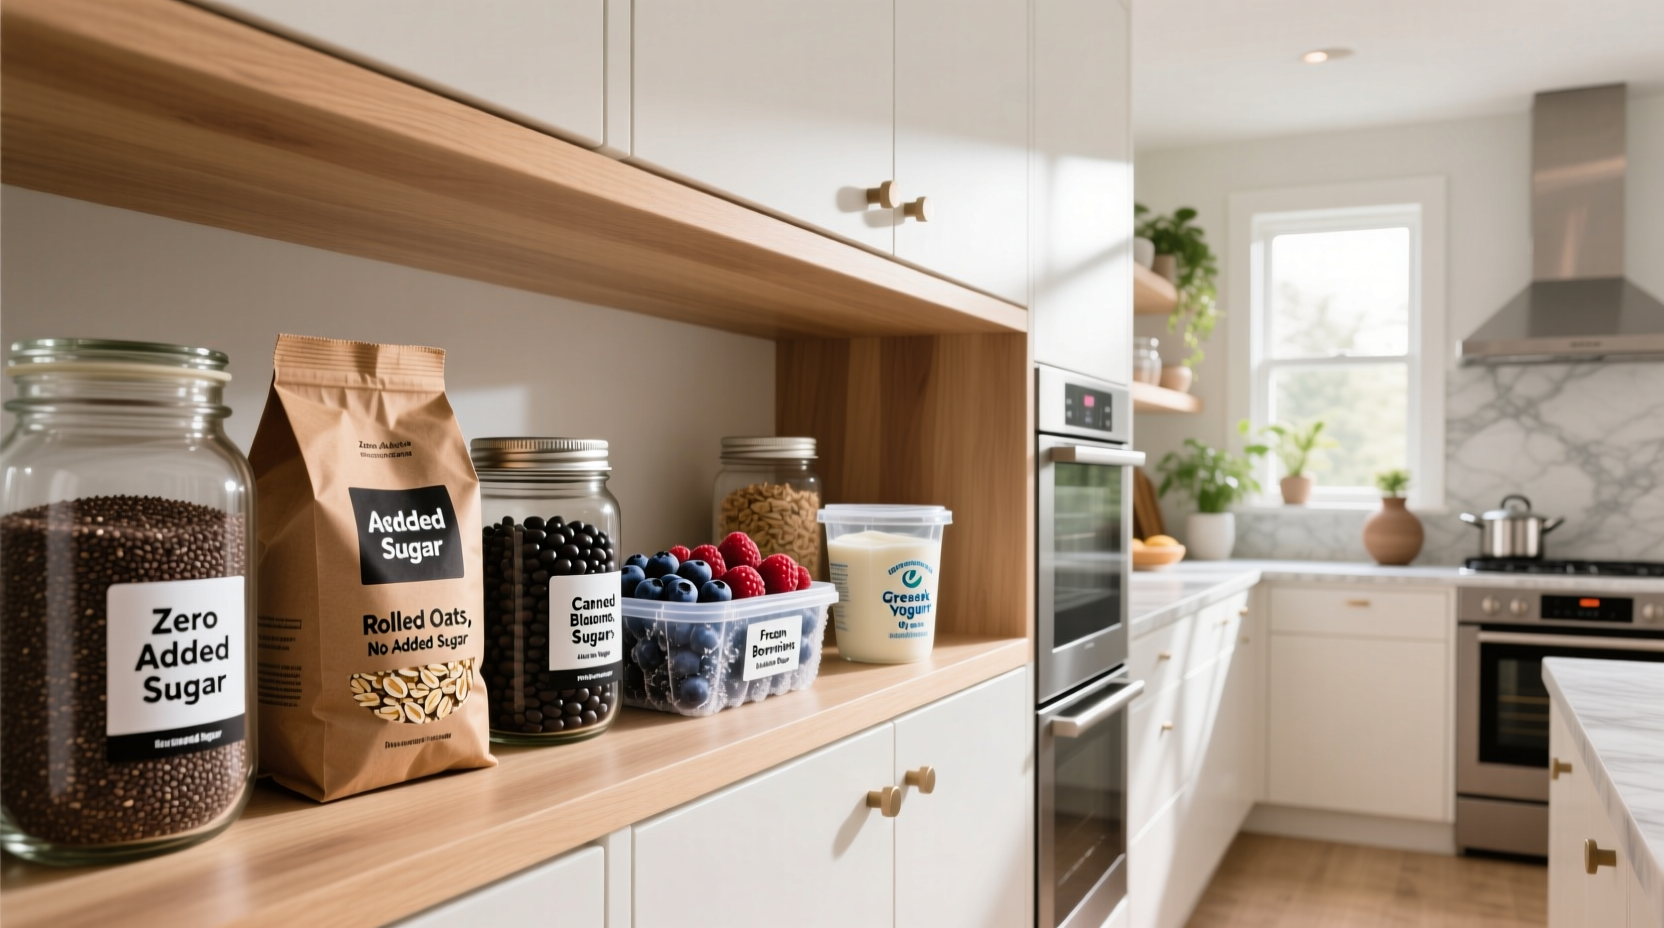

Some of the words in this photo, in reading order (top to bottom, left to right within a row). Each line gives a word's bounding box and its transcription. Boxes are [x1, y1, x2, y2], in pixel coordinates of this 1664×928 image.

[381, 537, 443, 564] Sugar
[572, 593, 615, 611] Canned
[152, 608, 218, 634] Zero
[363, 609, 425, 635] Rolled
[430, 608, 471, 628] Oats,
[135, 635, 229, 671] Added
[368, 641, 388, 656] No
[391, 635, 433, 654] Added
[438, 634, 468, 650] Sugar
[143, 674, 227, 705] Sugar
